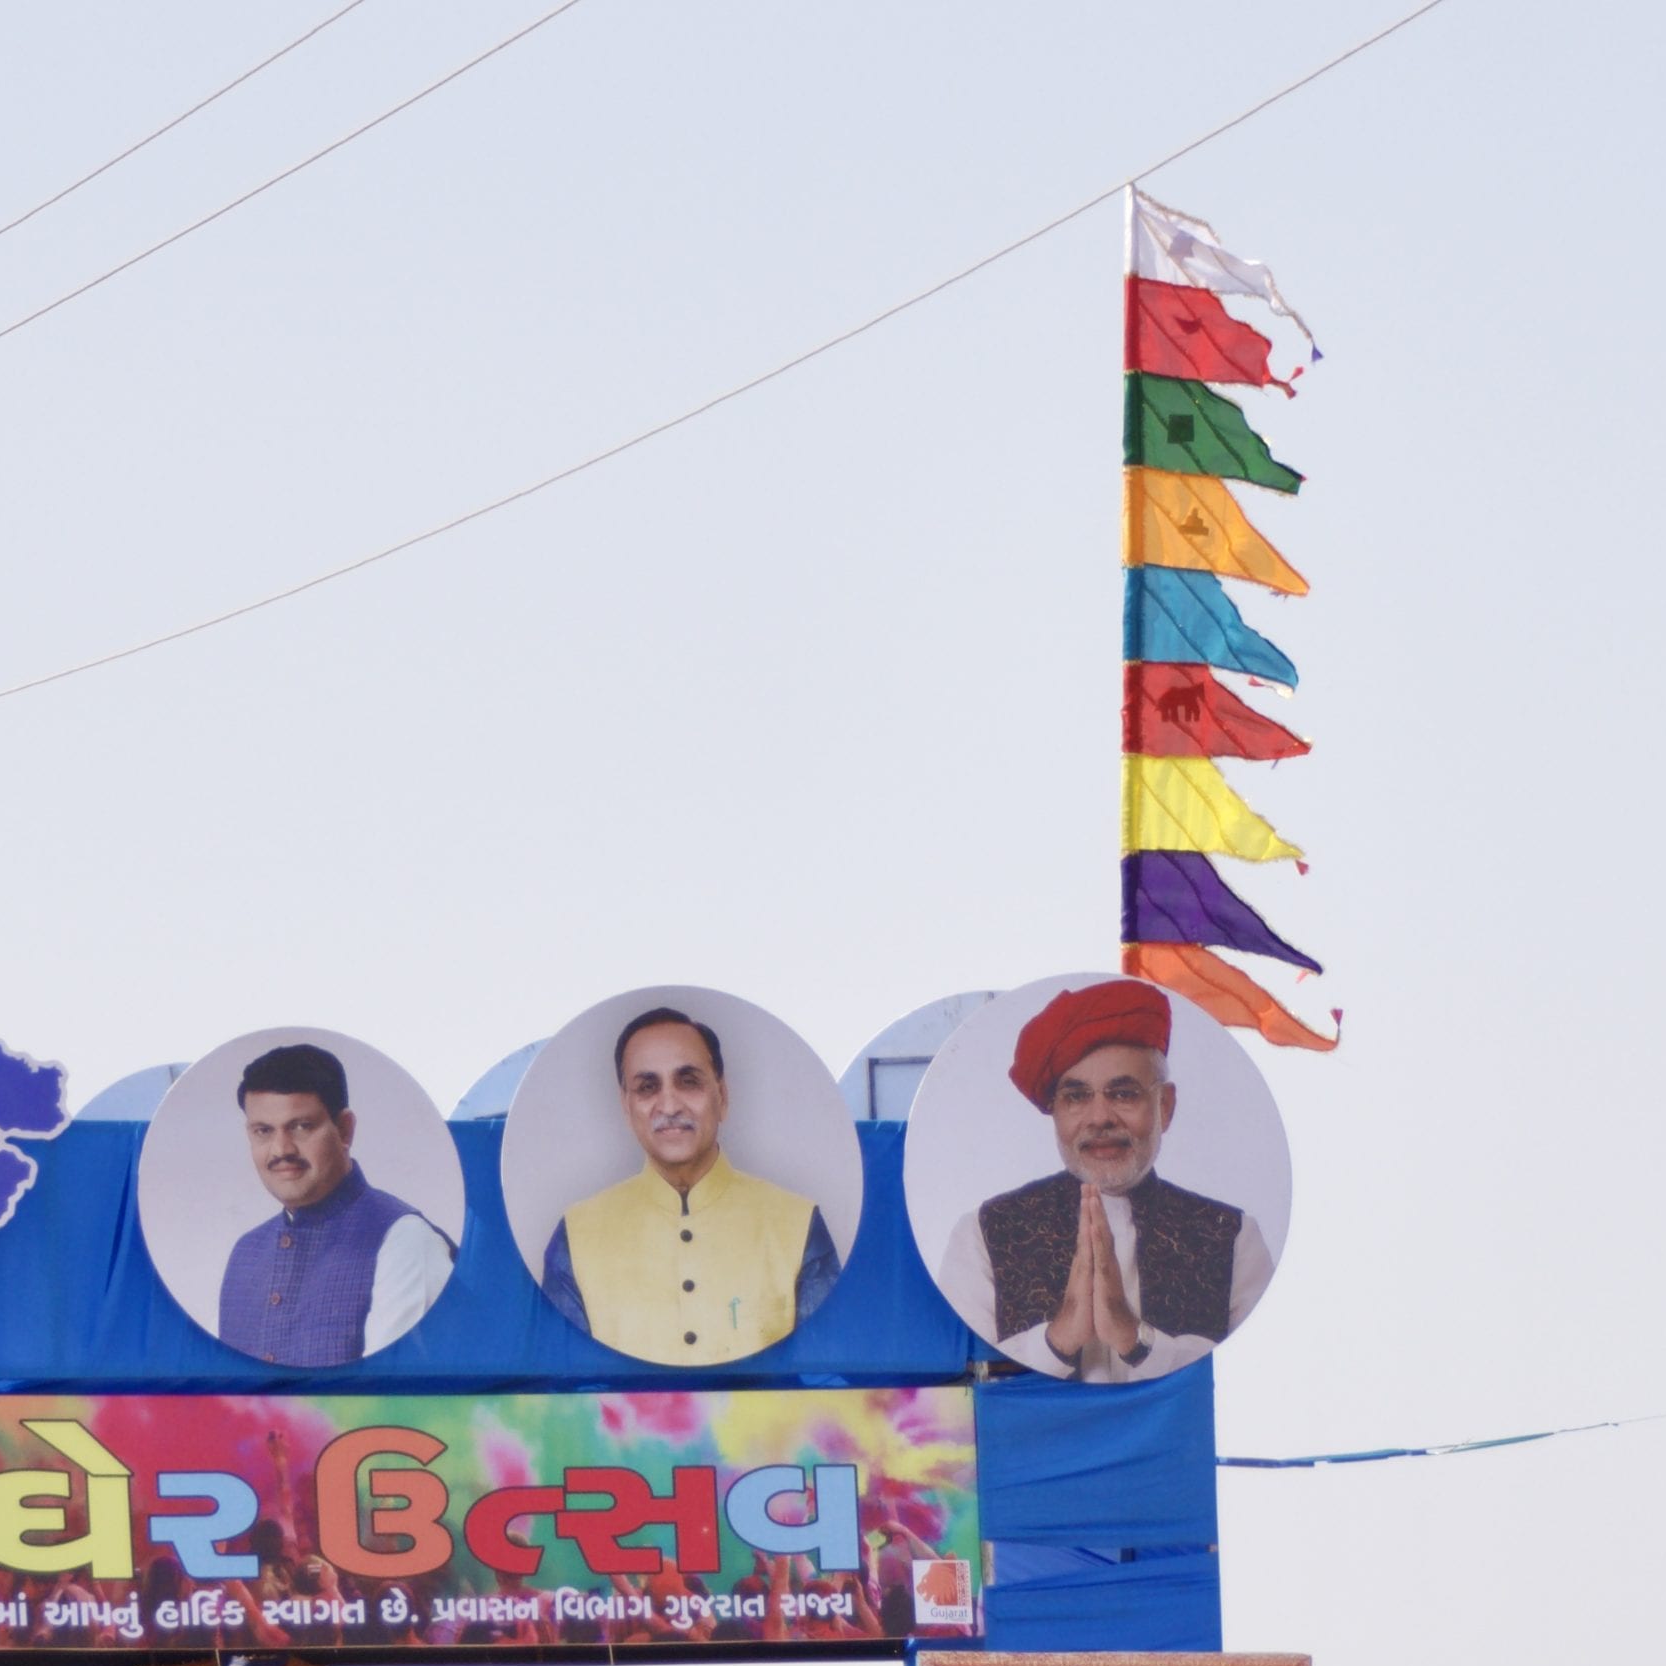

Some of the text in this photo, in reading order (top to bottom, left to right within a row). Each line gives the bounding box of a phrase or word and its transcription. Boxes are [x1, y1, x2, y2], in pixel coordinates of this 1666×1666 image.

[314, 1424, 862, 1579] ઉત્સવ
[44, 1591, 144, 1638] આપનું
[155, 1588, 245, 1628] હાર્દિક
[262, 1599, 365, 1625] સ્વાગત
[380, 1587, 419, 1625] છે.
[431, 1596, 539, 1621] પ્રવાસન
[554, 1586, 652, 1621] વિભાગ
[664, 1593, 765, 1630] ગુજરાત
[780, 1592, 854, 1618] રાજ્ય
[930, 1607, 969, 1619] Gujarat
